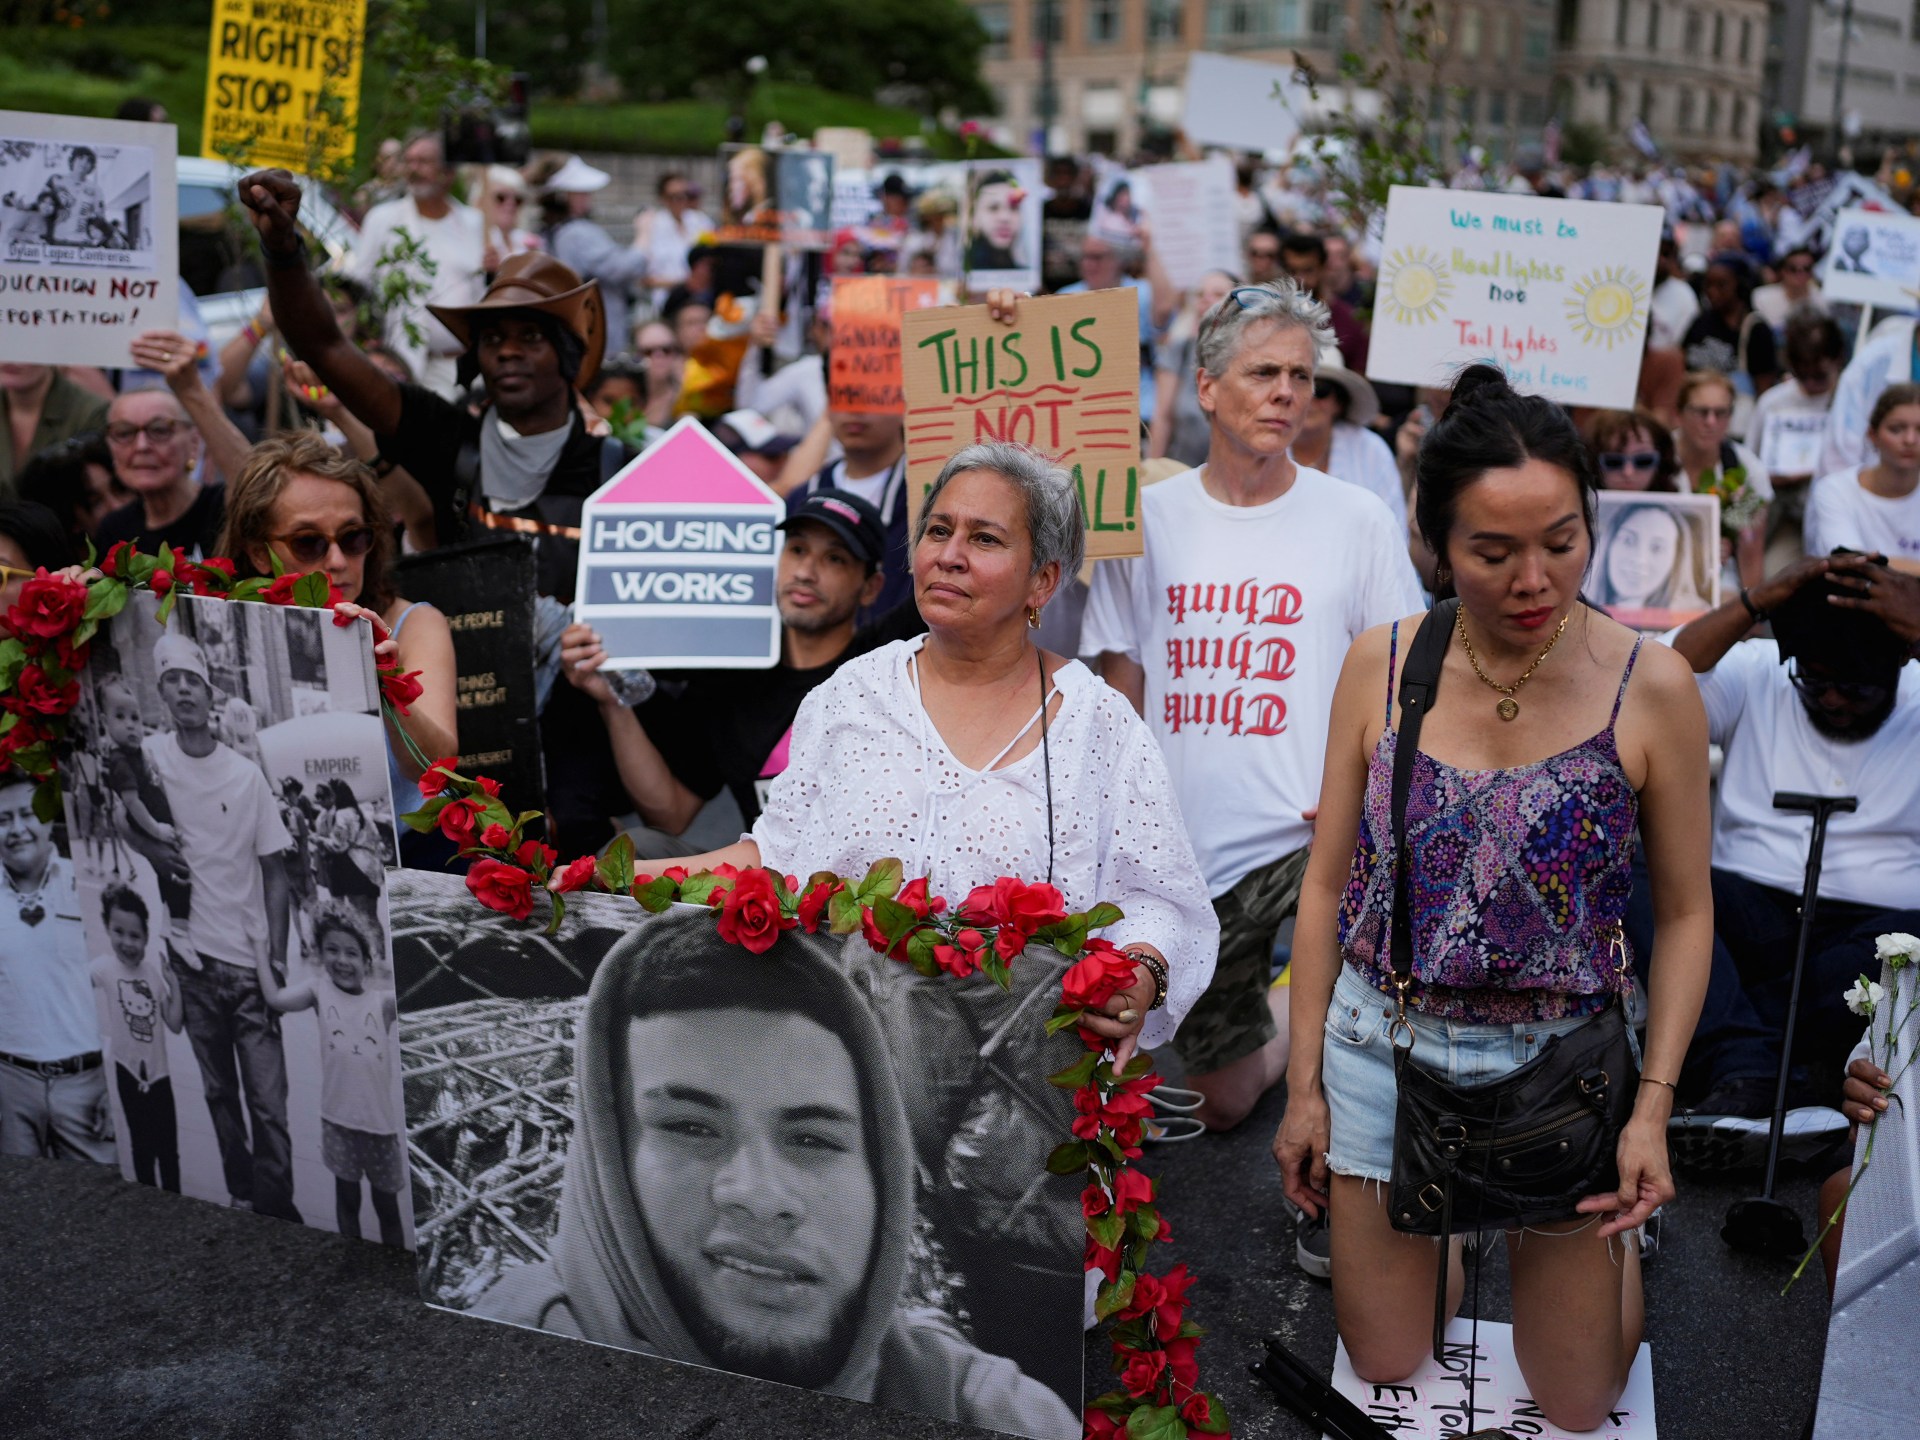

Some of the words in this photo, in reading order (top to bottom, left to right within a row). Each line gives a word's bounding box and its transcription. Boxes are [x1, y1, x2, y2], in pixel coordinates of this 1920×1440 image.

[215, 73, 292, 115] STOP
[1450, 208, 1483, 229] We
[1492, 214, 1544, 236] must
[1556, 219, 1579, 239] be
[109, 277, 160, 300] NOT
[1489, 282, 1526, 304] not
[918, 328, 1028, 394] THIS
[1051, 317, 1103, 382] IS
[974, 400, 1073, 451] NOT
[594, 520, 771, 550] HOUSING
[612, 571, 754, 601] WORKS
[1166, 577, 1304, 626] Think
[464, 610, 504, 630] PEOPLE
[1166, 631, 1296, 682] Think
[1164, 686, 1288, 738] Think
[304, 757, 361, 775] EMPIRE
[1440, 1342, 1491, 1390] Not
